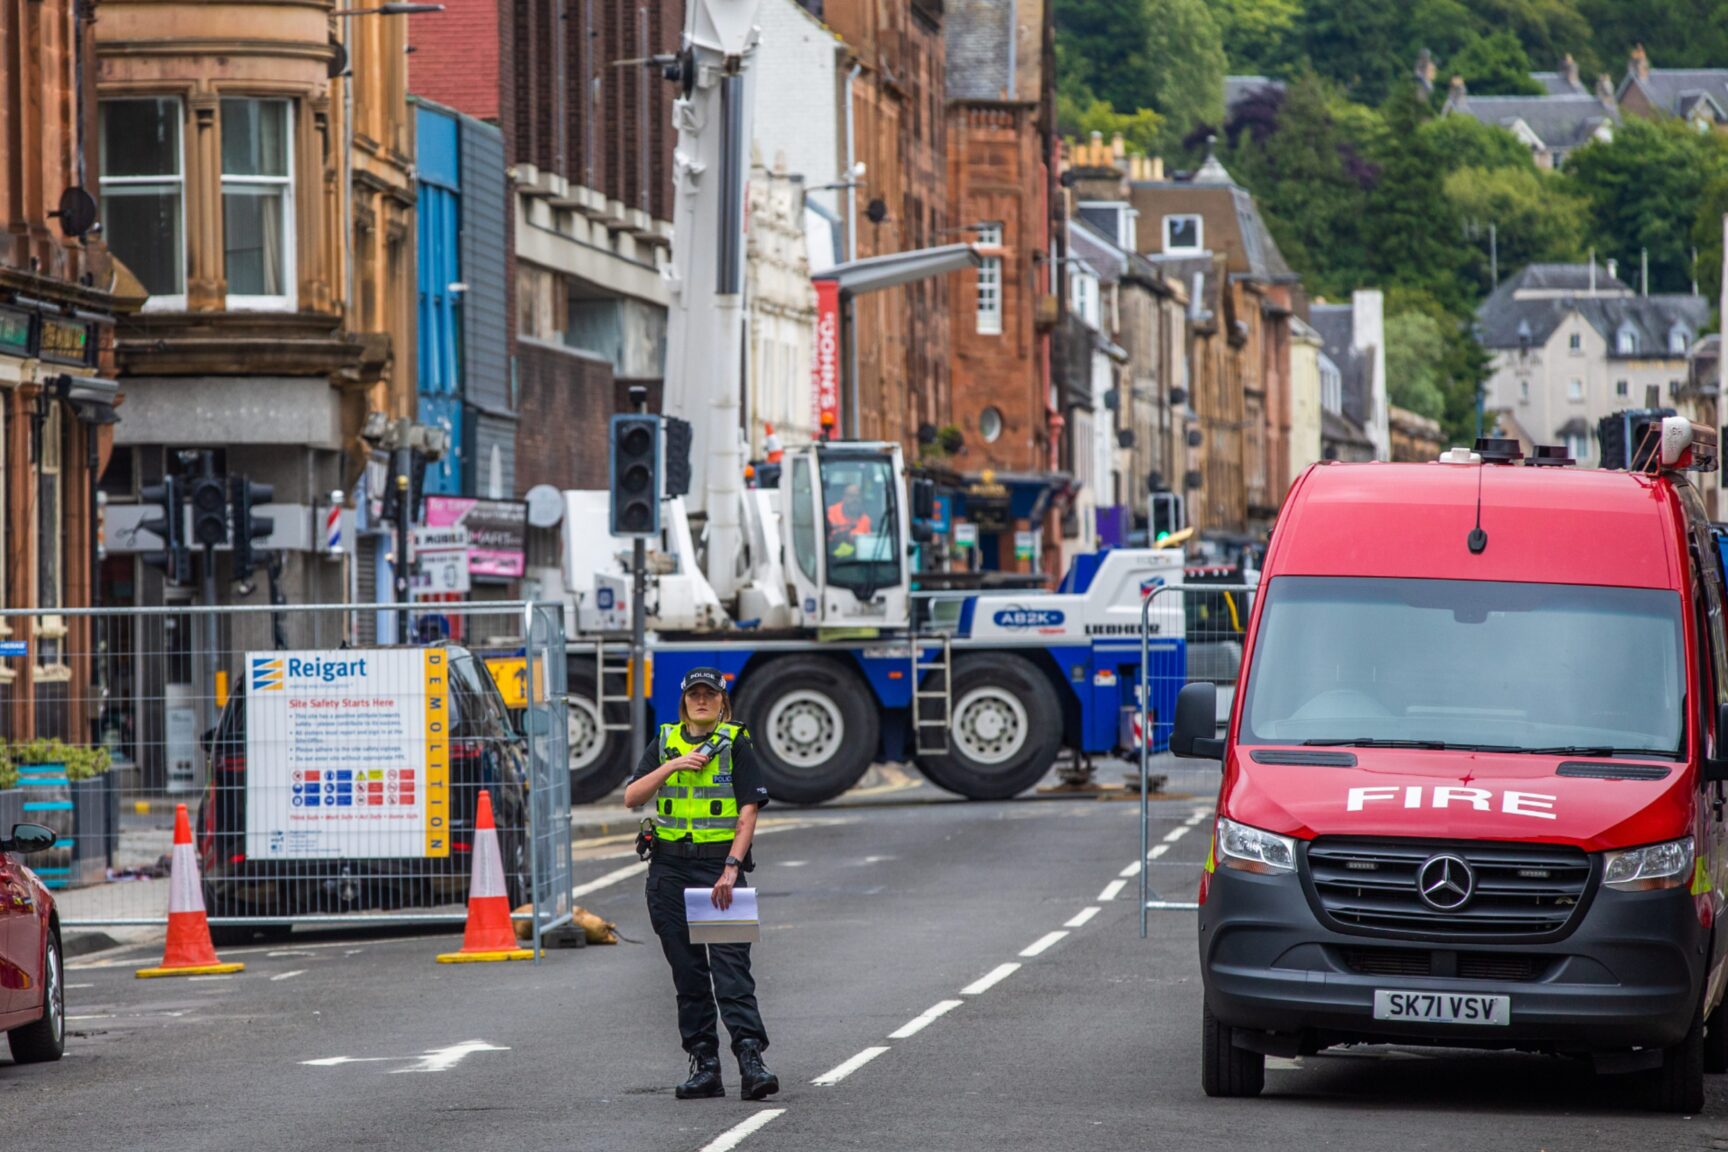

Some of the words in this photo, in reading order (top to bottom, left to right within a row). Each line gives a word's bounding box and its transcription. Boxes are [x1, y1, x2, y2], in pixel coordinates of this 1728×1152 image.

[288, 656, 367, 682] Reigart
[690, 672, 715, 680] POLICE
[289, 698, 307, 708] Site
[310, 698, 339, 710] Safety
[342, 698, 370, 708] Starts
[373, 698, 394, 707] Here
[428, 654, 443, 849] DEMOLITION
[713, 775, 733, 783] POLIC
[1346, 786, 1557, 820] FIRE
[1390, 994, 1442, 1018] SK71
[1449, 996, 1495, 1020] VSV
